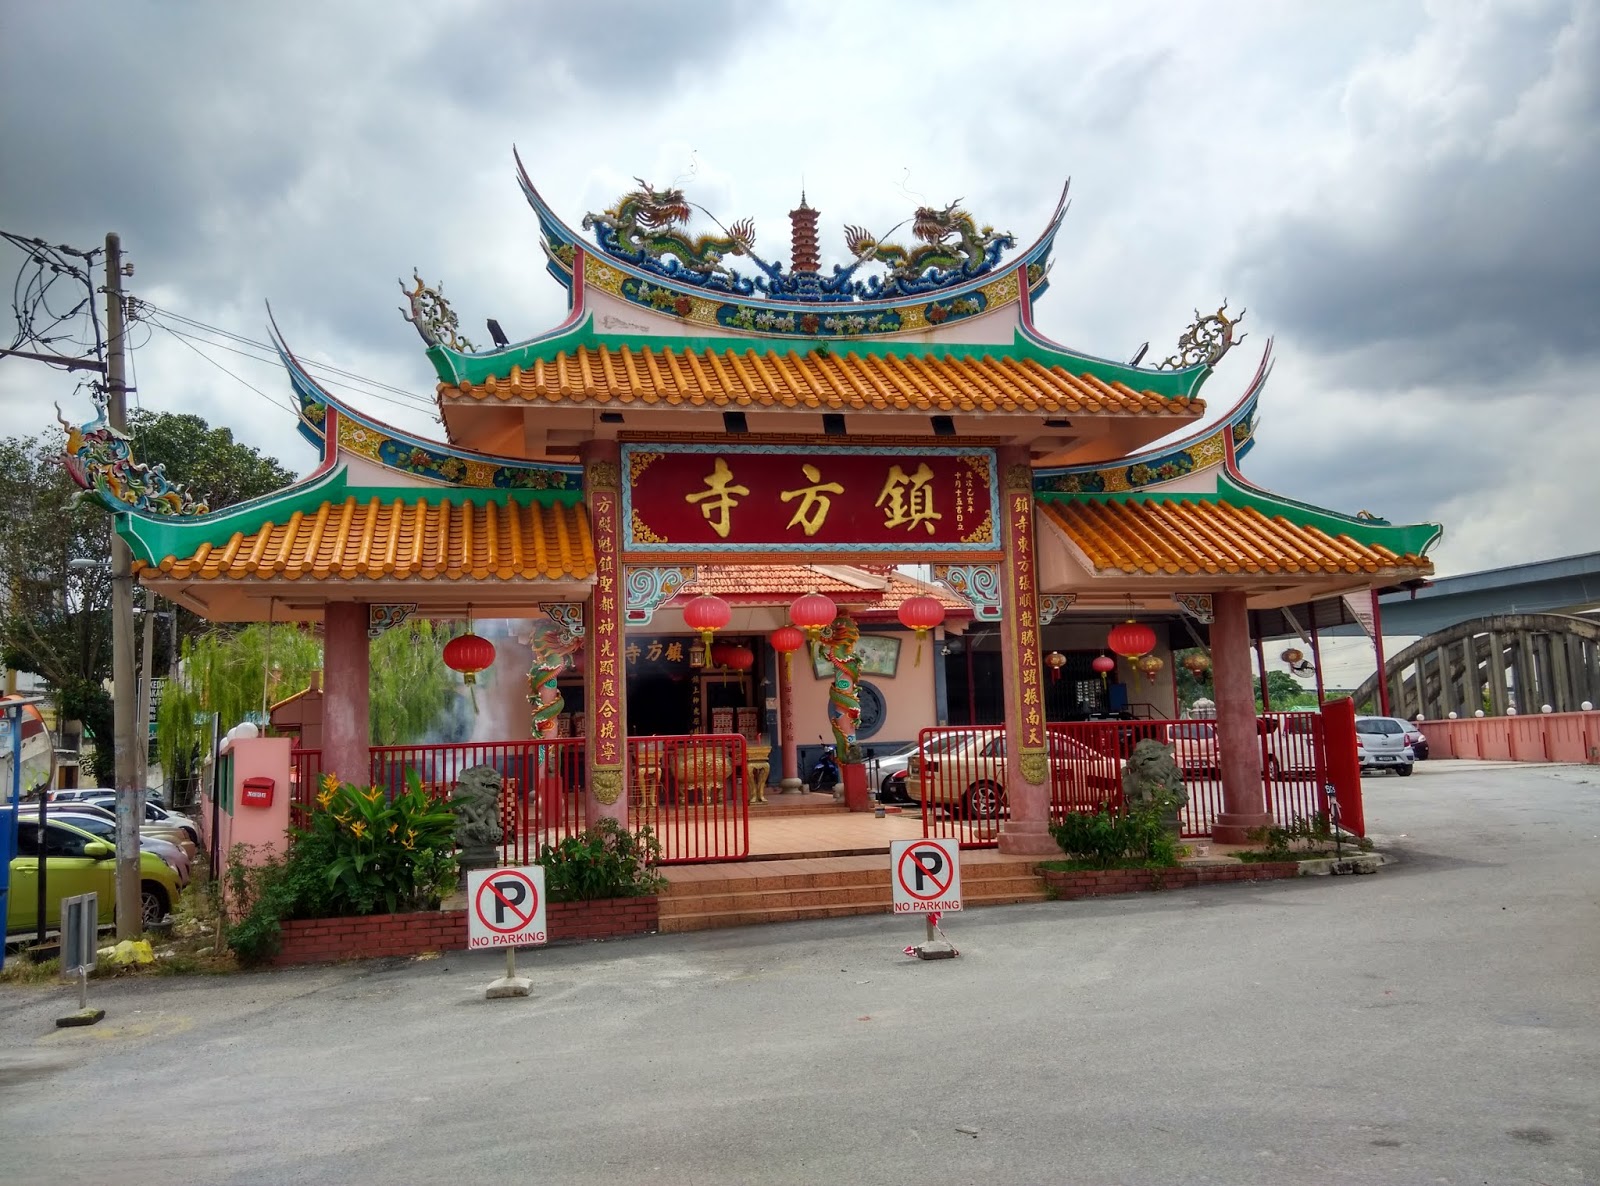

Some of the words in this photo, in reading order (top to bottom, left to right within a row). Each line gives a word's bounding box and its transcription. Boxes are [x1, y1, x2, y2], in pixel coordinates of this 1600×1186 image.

[685, 457, 942, 538] 鎮方寺
[895, 902, 910, 911] NO
[913, 900, 960, 911] PARKING
[472, 936, 489, 947] NO
[492, 931, 545, 944] PARKING
